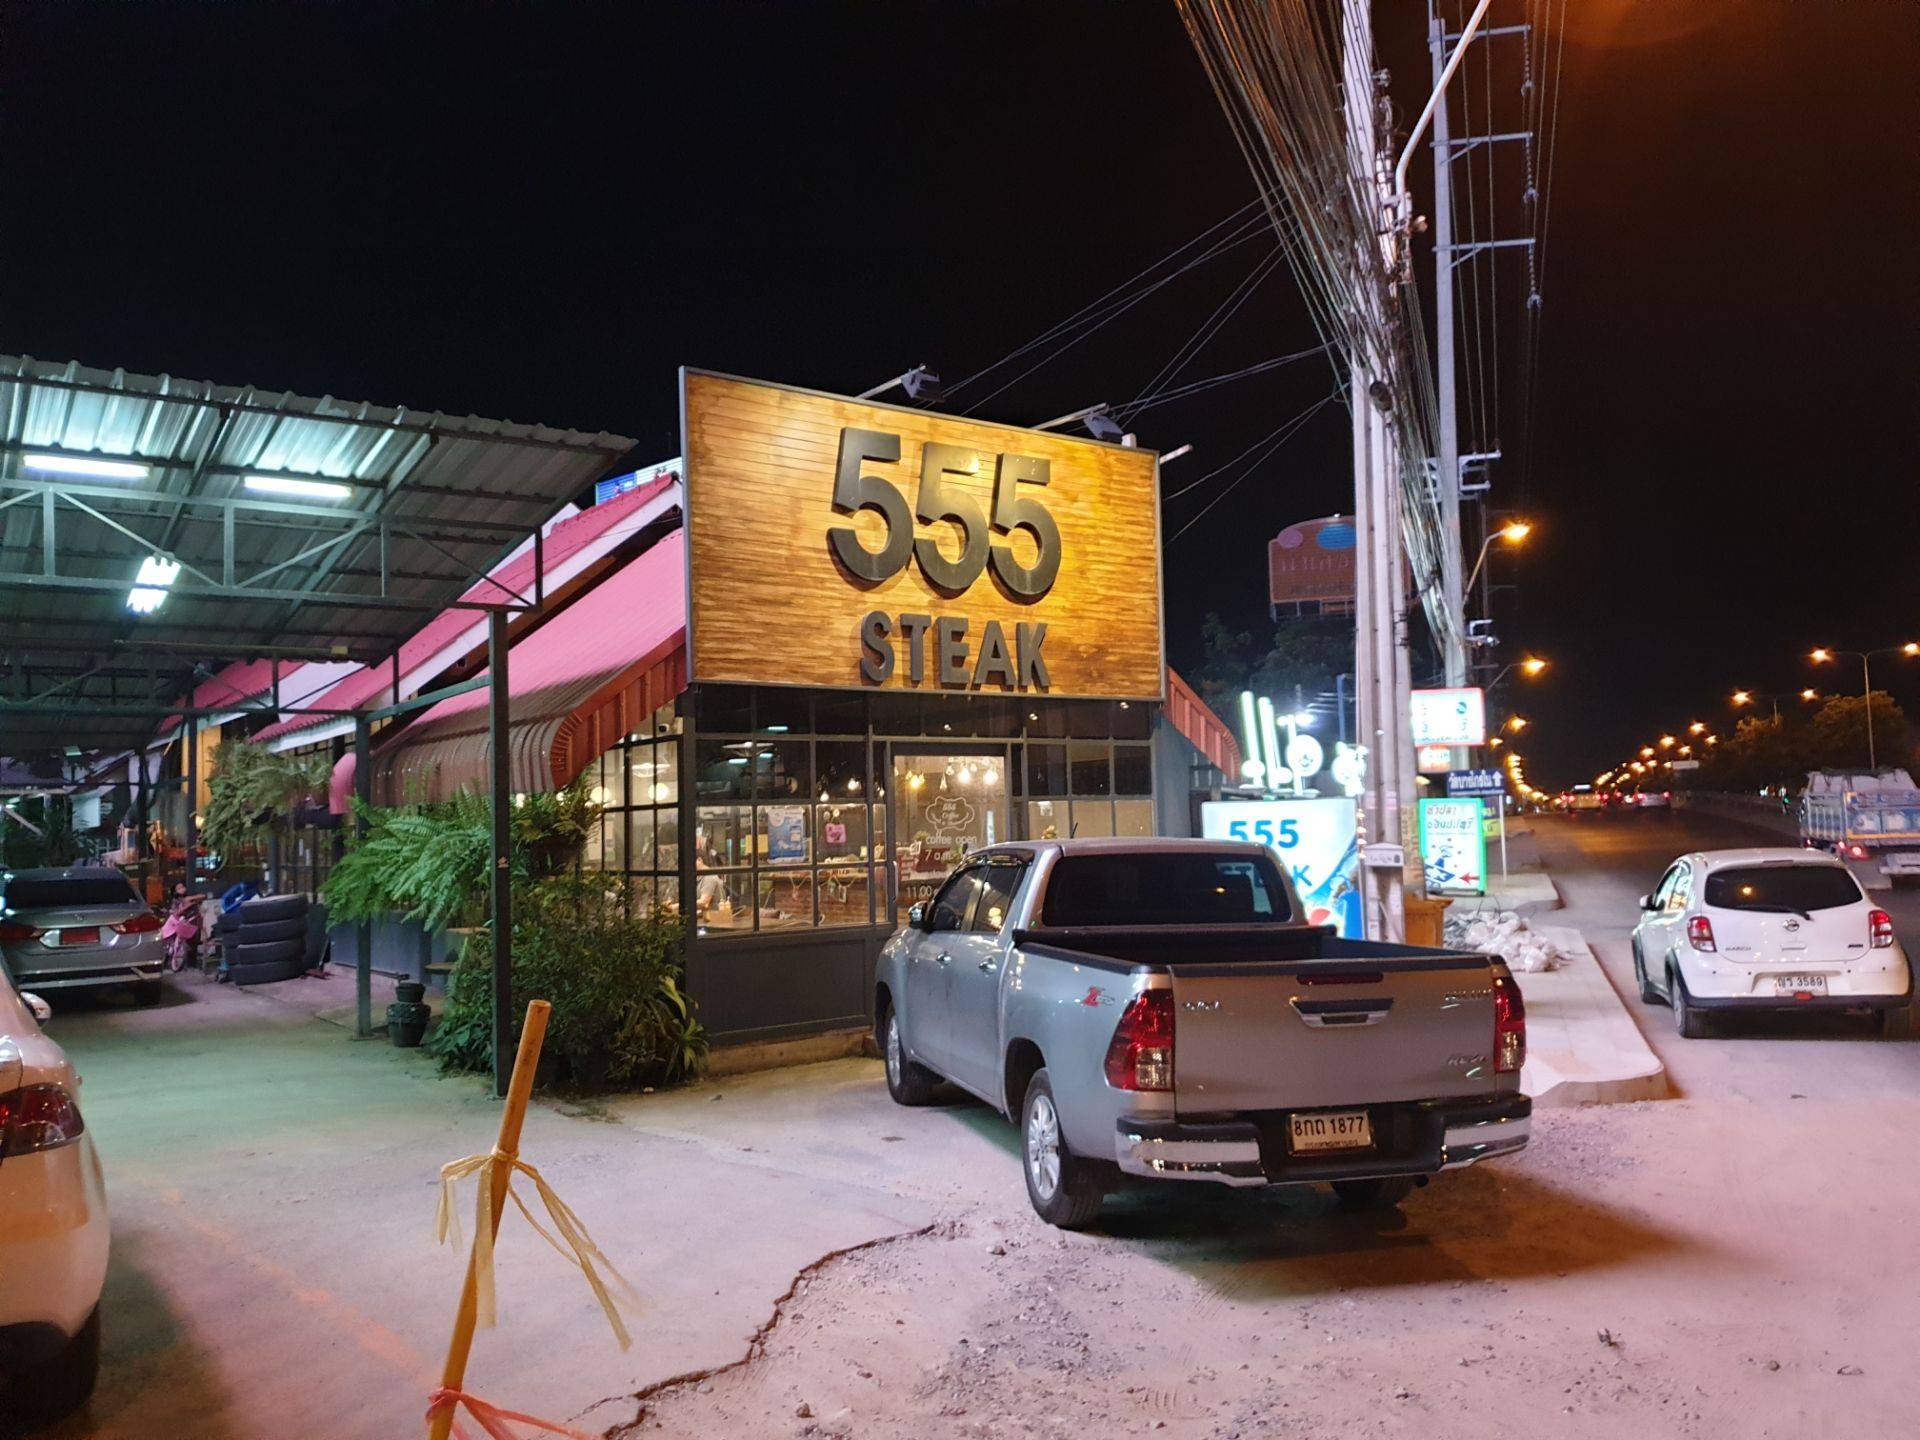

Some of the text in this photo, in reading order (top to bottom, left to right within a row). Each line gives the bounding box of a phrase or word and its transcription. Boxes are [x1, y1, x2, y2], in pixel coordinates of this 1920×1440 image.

[826, 426, 1062, 606] 555
[859, 610, 1053, 691] STEAK
[1229, 819, 1300, 848] 555
[1329, 1116, 1364, 1134] 1877
